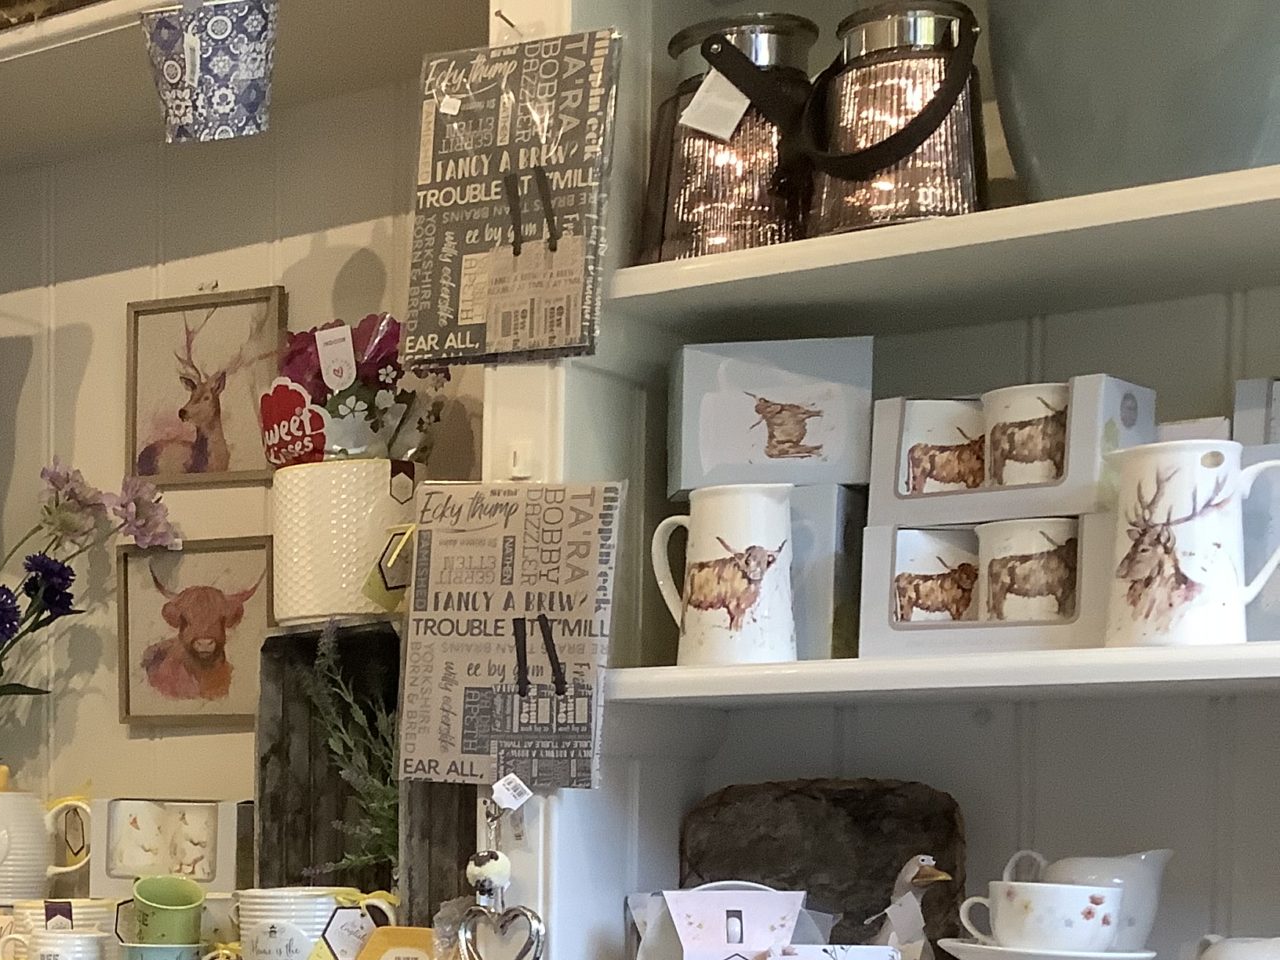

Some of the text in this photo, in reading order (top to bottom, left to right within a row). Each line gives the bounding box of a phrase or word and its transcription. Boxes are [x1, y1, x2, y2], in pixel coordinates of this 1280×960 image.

[499, 150, 511, 173] A
[417, 180, 503, 209] TROUBLE
[420, 213, 437, 310] YORKSHIRE
[405, 333, 439, 354] EAR
[265, 407, 312, 446] weet
[419, 491, 519, 529] Ecky thump
[521, 488, 543, 587] DAZZLER
[539, 488, 566, 585] BOBBY
[564, 486, 595, 585] TA'RA
[433, 591, 494, 612] FANCY
[503, 591, 515, 612] A
[413, 617, 505, 637] TROUBLE
[408, 641, 422, 687] BORN
[488, 659, 506, 683] by
[418, 642, 435, 735] YORKSHIRE
[404, 710, 418, 754] BRED
[403, 759, 440, 776] EAR
